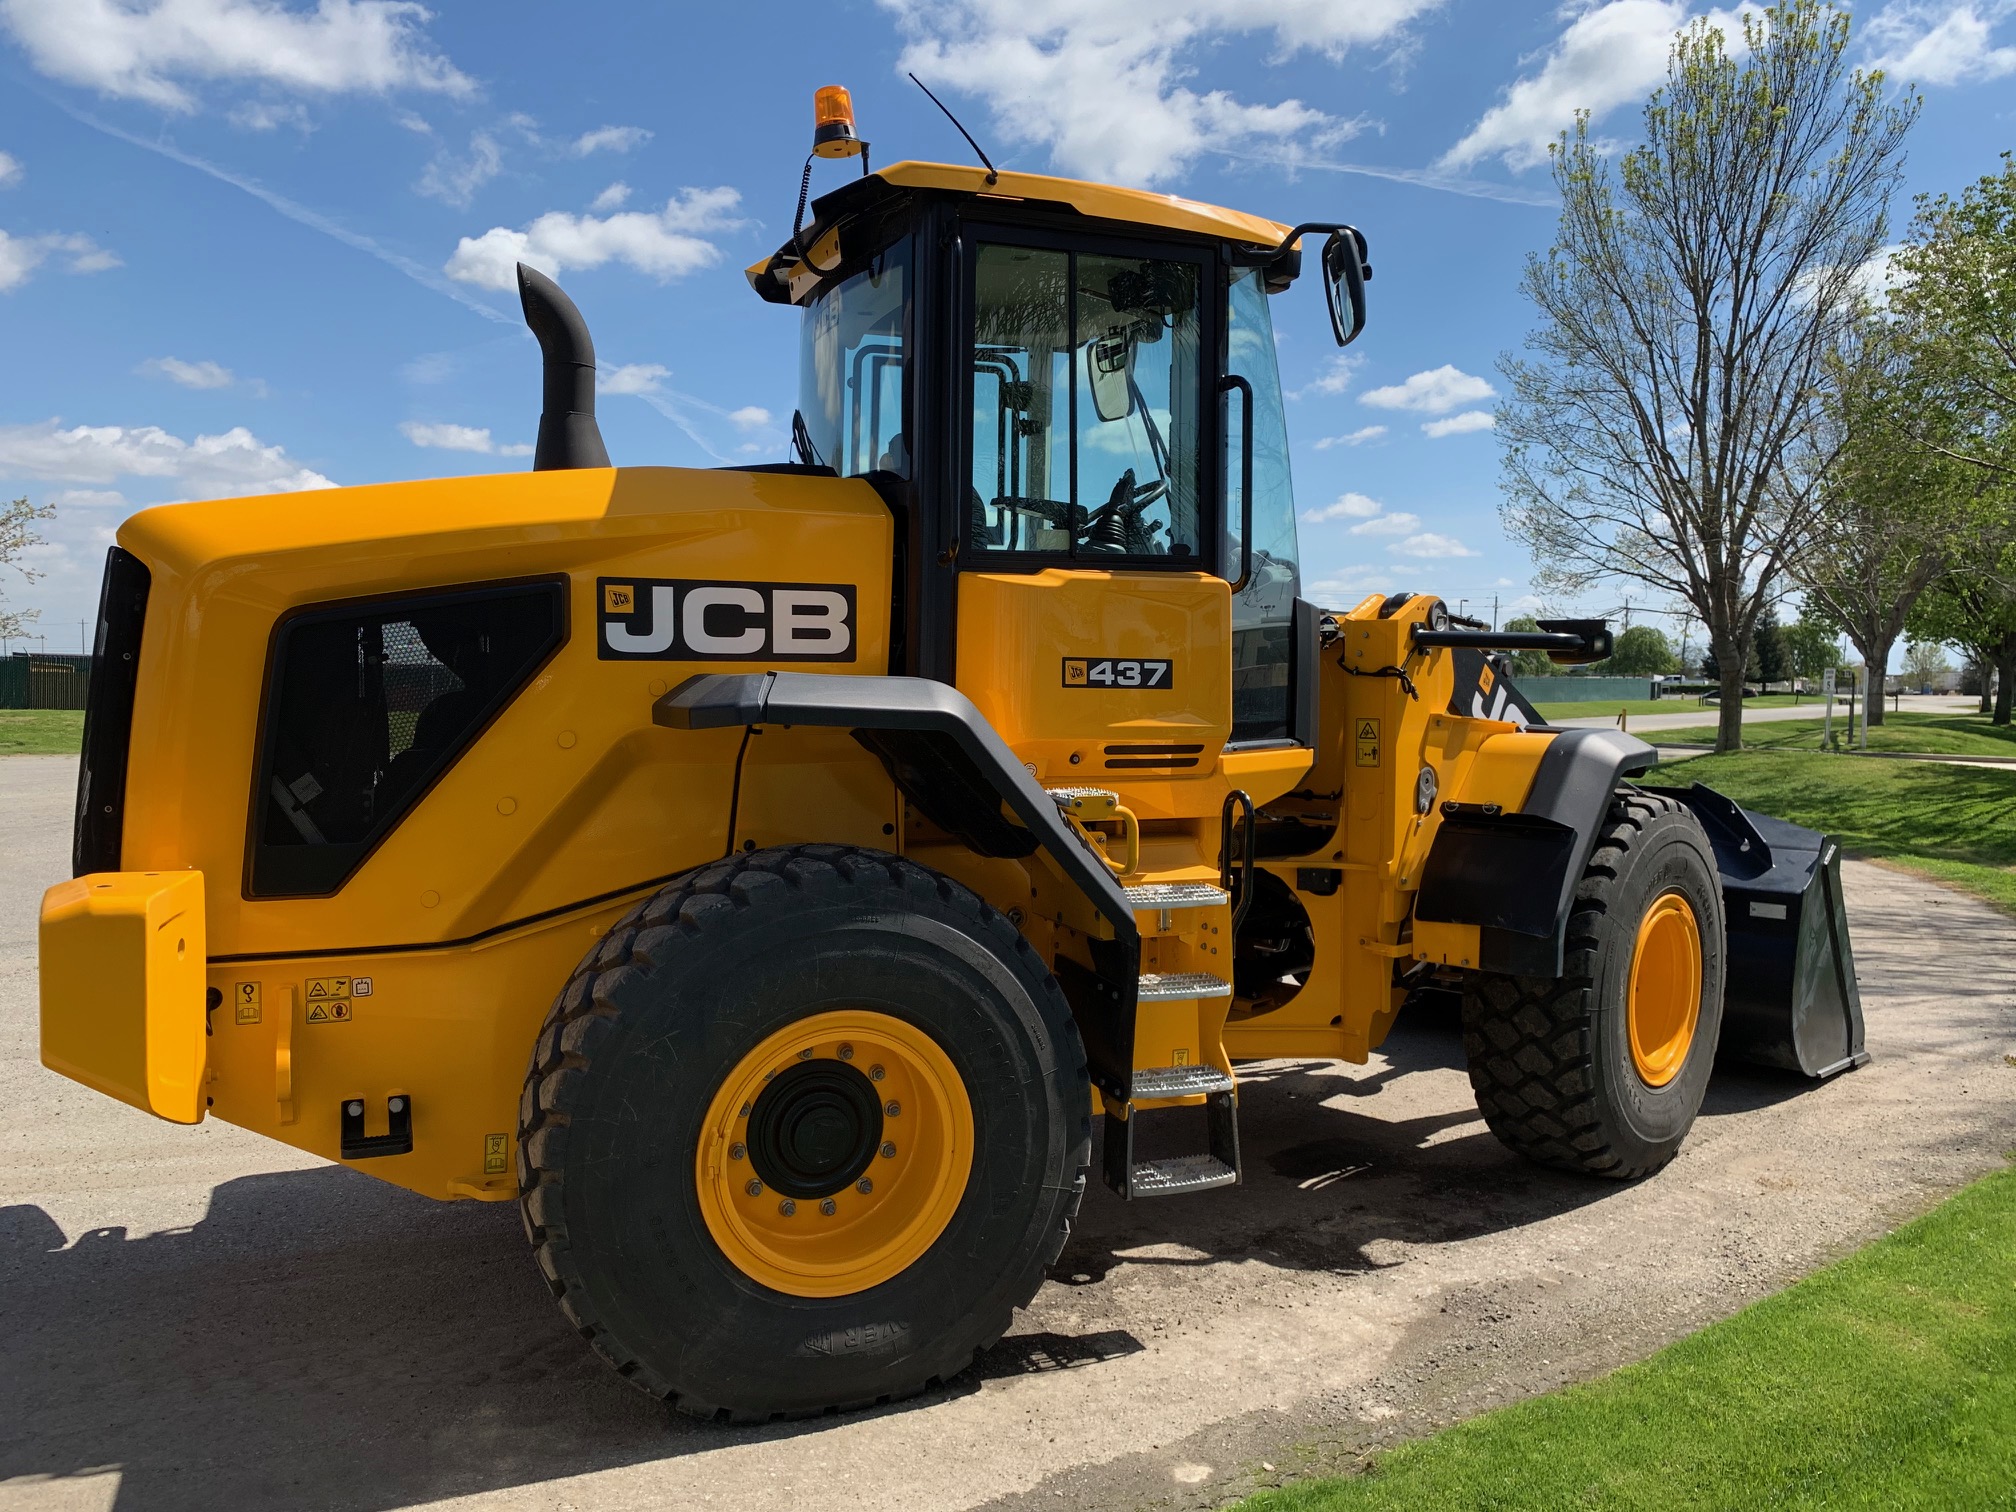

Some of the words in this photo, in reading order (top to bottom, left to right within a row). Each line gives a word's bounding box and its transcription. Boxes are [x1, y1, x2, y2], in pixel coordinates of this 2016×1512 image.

[605, 586, 851, 654] JCB
[612, 591, 631, 606] JCB
[1089, 661, 1168, 686] 437
[964, 1007, 1020, 1107] RADIAL
